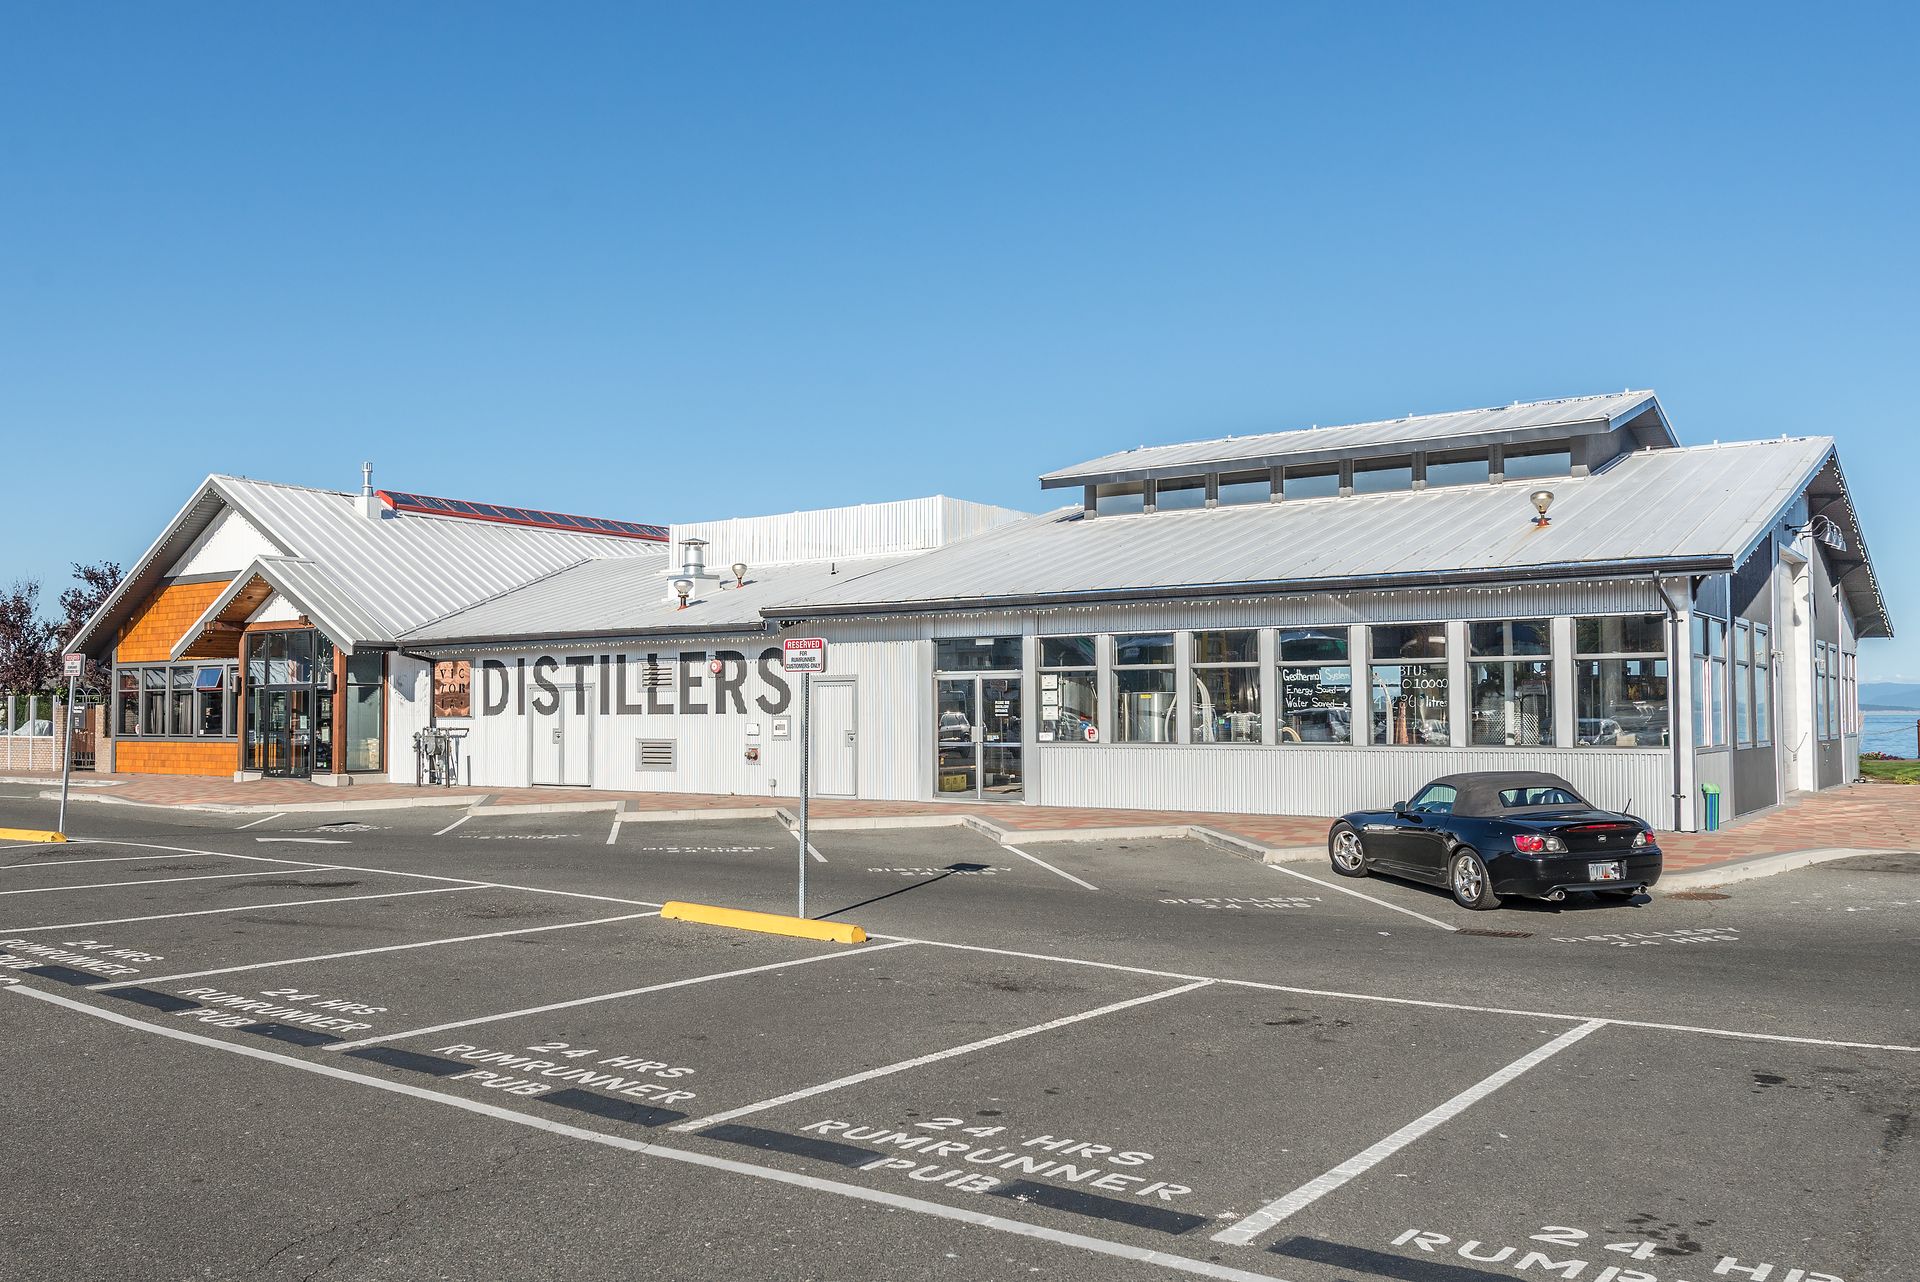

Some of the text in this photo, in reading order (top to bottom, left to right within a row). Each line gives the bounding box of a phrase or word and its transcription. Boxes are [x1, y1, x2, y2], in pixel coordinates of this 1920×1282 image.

[787, 640, 820, 649] RESERVED
[440, 668, 465, 679] VIC
[483, 647, 792, 715] DISTILLERS
[1325, 668, 1350, 681] System
[440, 683, 466, 694] TOR
[1285, 694, 1335, 708] Water Saved
[1286, 684, 1313, 695] Energy
[1425, 695, 1449, 707] litres
[0, 938, 139, 975] RUMRUNNER
[63, 940, 165, 961] 24 HRS
[177, 987, 373, 1032] RUMRUNNER
[260, 988, 388, 1014] 24 HRS
[175, 1009, 257, 1028] PUB
[527, 1042, 695, 1078] 24 HRS
[431, 1044, 697, 1104] RUMRUNNER
[450, 1070, 552, 1095] PUB
[914, 1117, 1155, 1166] 24 HRS
[799, 1119, 1192, 1201] RUMRUNNER
[858, 1157, 1001, 1194] PUB
[1528, 1225, 1658, 1260] 24
